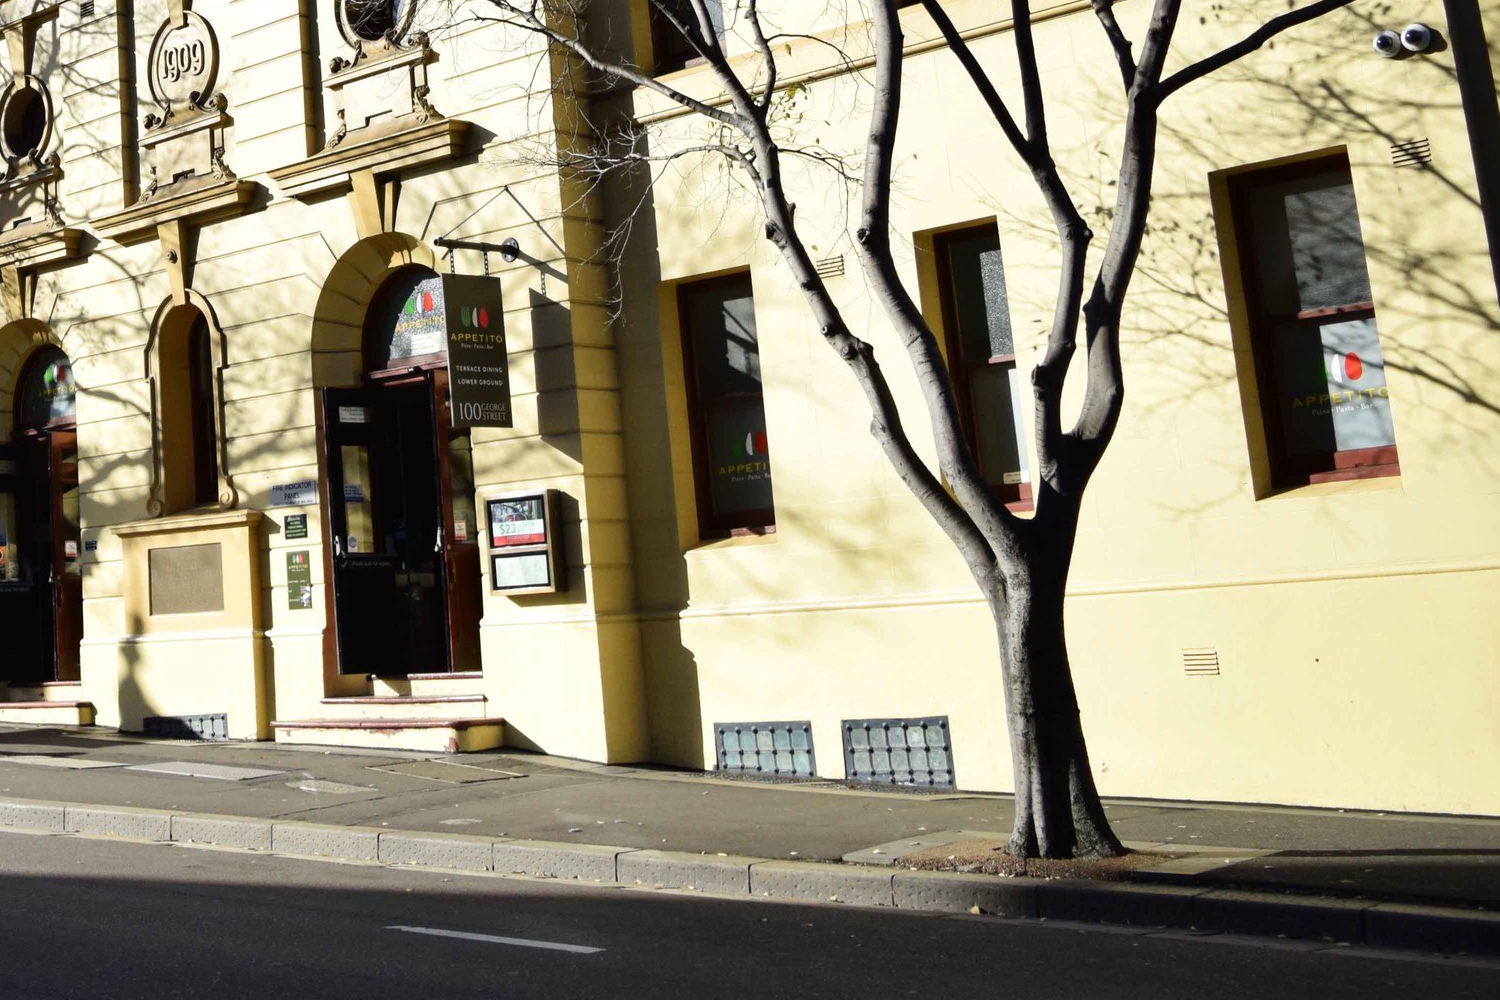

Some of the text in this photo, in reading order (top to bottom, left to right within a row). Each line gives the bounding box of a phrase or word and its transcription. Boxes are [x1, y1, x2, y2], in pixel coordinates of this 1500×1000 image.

[162, 39, 205, 83] 1909
[450, 332, 503, 343] APPETITO
[1293, 386, 1389, 407] APPETITO
[459, 402, 482, 420] 100
[481, 402, 506, 411] GEORGE
[482, 411, 506, 420] STREET
[718, 461, 770, 475] APPETI
[285, 481, 312, 490] INDICATOR
